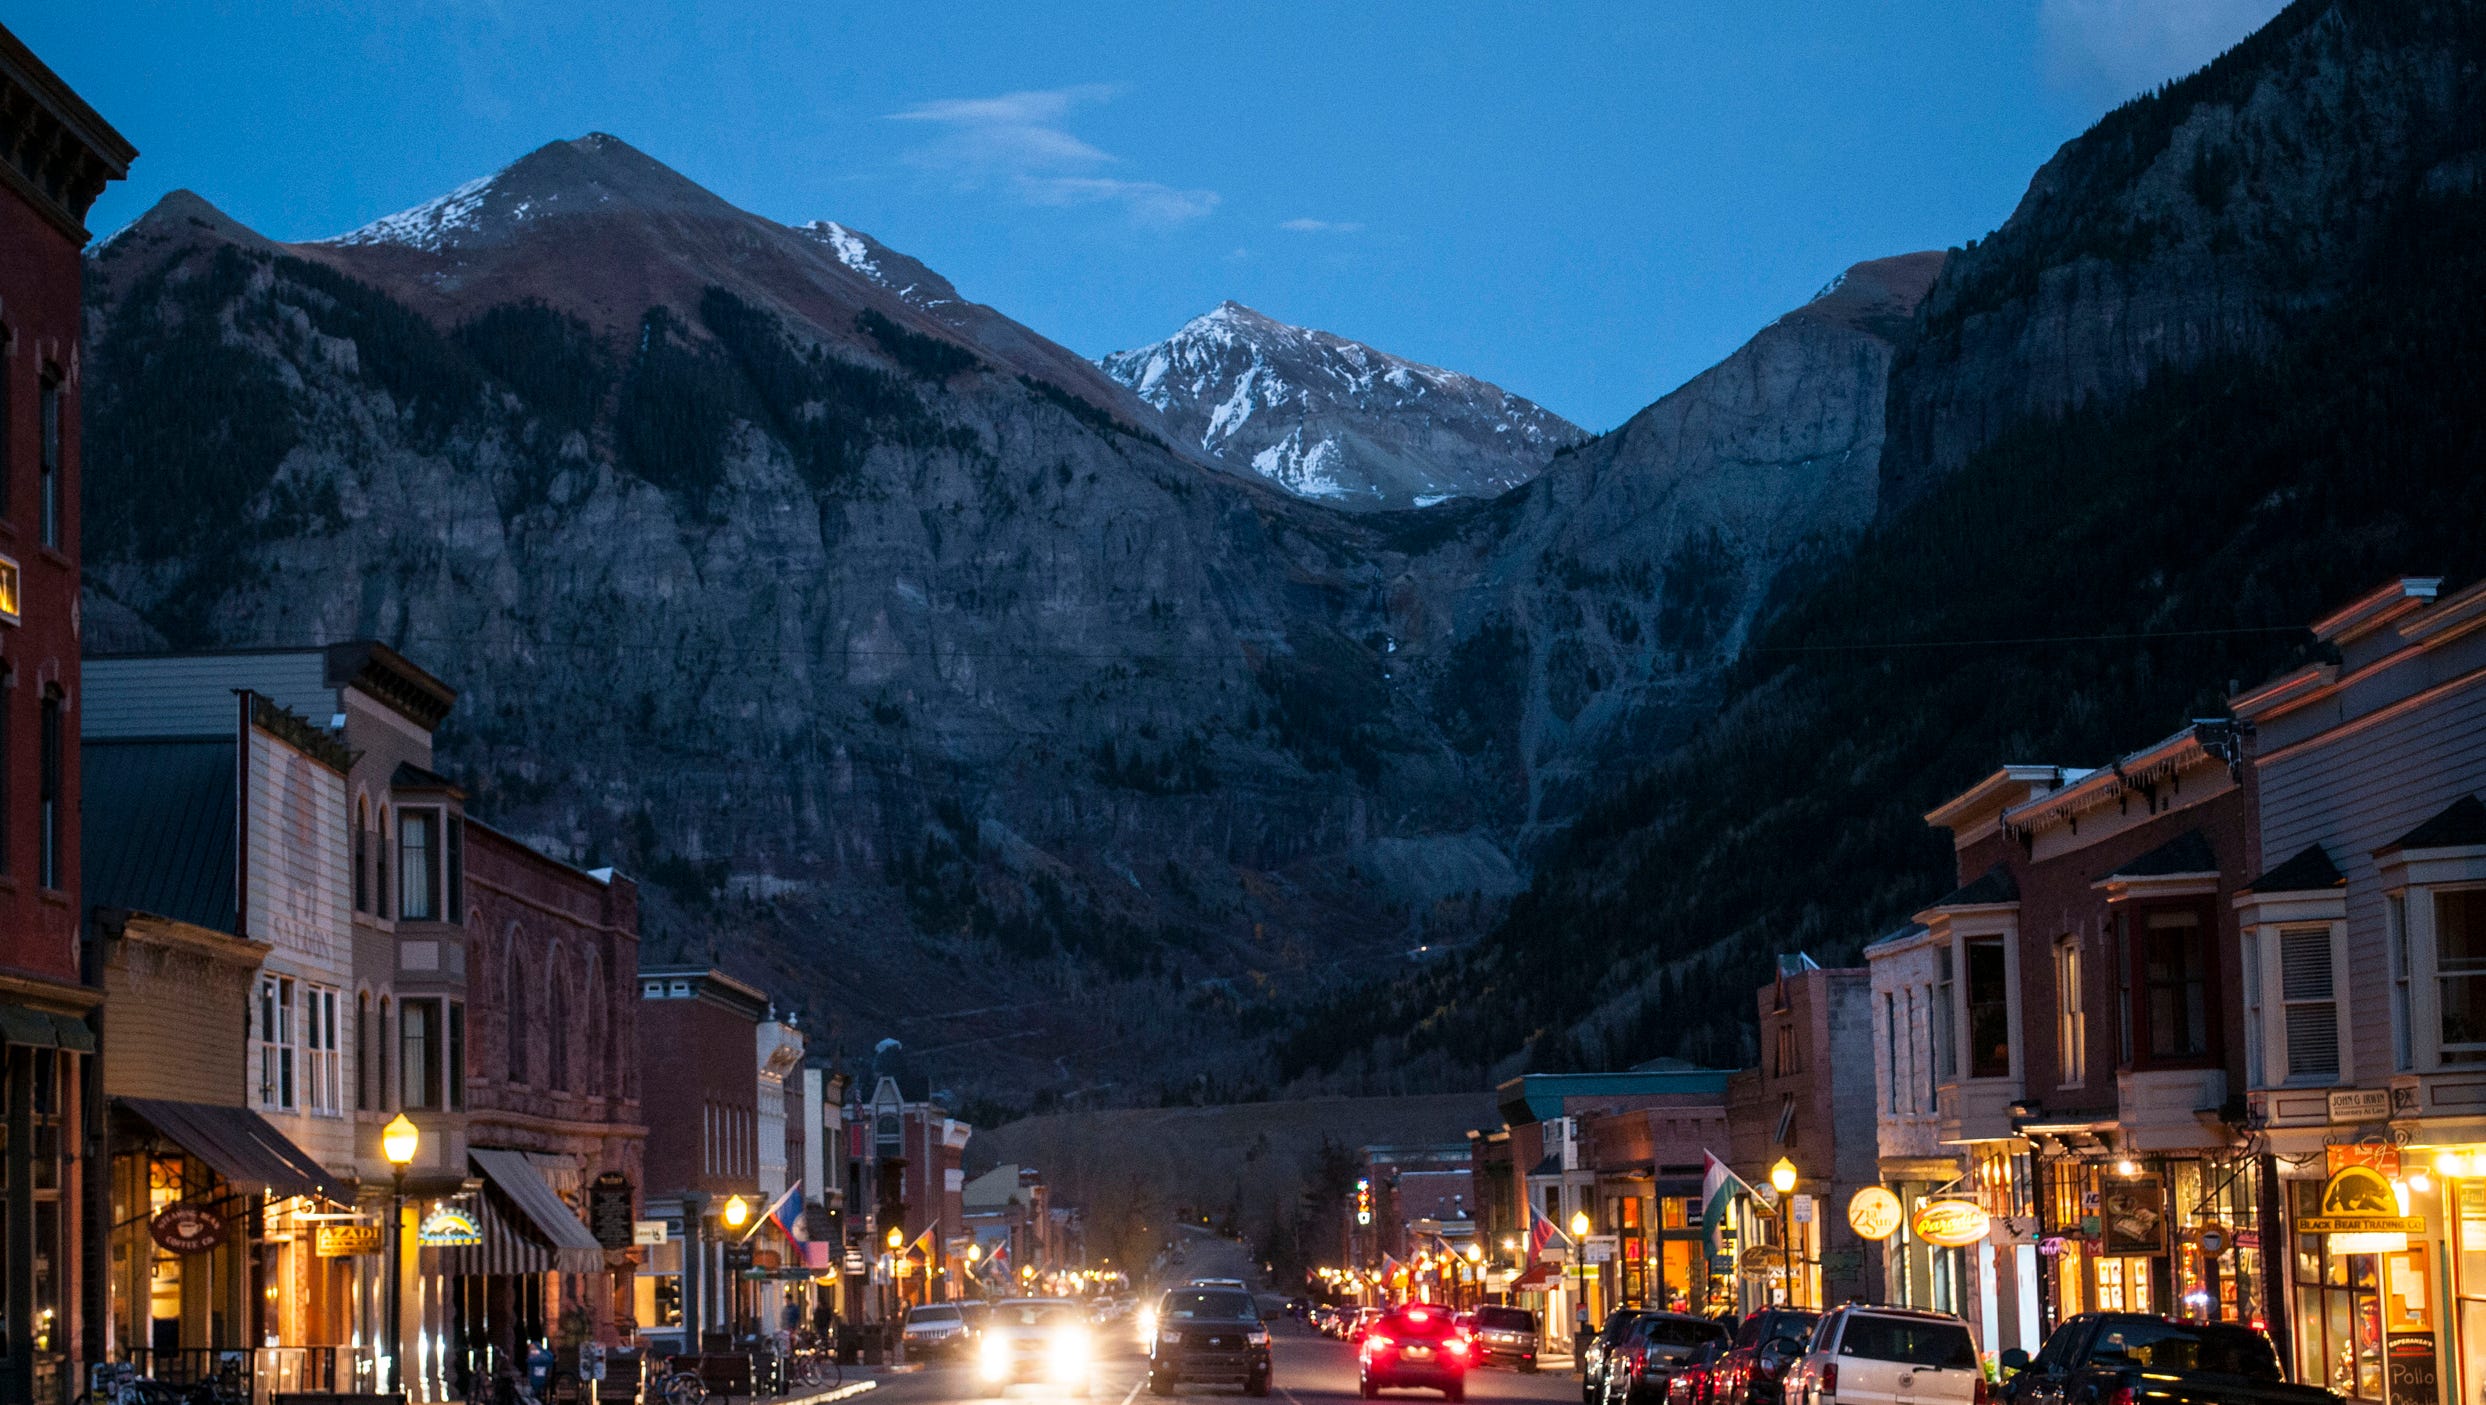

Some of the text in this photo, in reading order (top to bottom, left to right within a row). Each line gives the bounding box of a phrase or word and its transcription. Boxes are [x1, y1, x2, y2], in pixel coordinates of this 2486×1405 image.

[2332, 1095, 2352, 1107] JOHN
[2363, 1093, 2385, 1105] IRWIN
[2334, 1109, 2362, 1117] Attorney
[1851, 1207, 1877, 1227] Zia
[1865, 1218, 1892, 1235] Sun
[2300, 1220, 2331, 1230] BLACK
[2334, 1220, 2360, 1230] BEAR
[2363, 1219, 2404, 1230] TRADING
[320, 1227, 378, 1239] AZADI
[165, 1236, 198, 1249] COFFEE
[2390, 1363, 2434, 1385] Pollo
